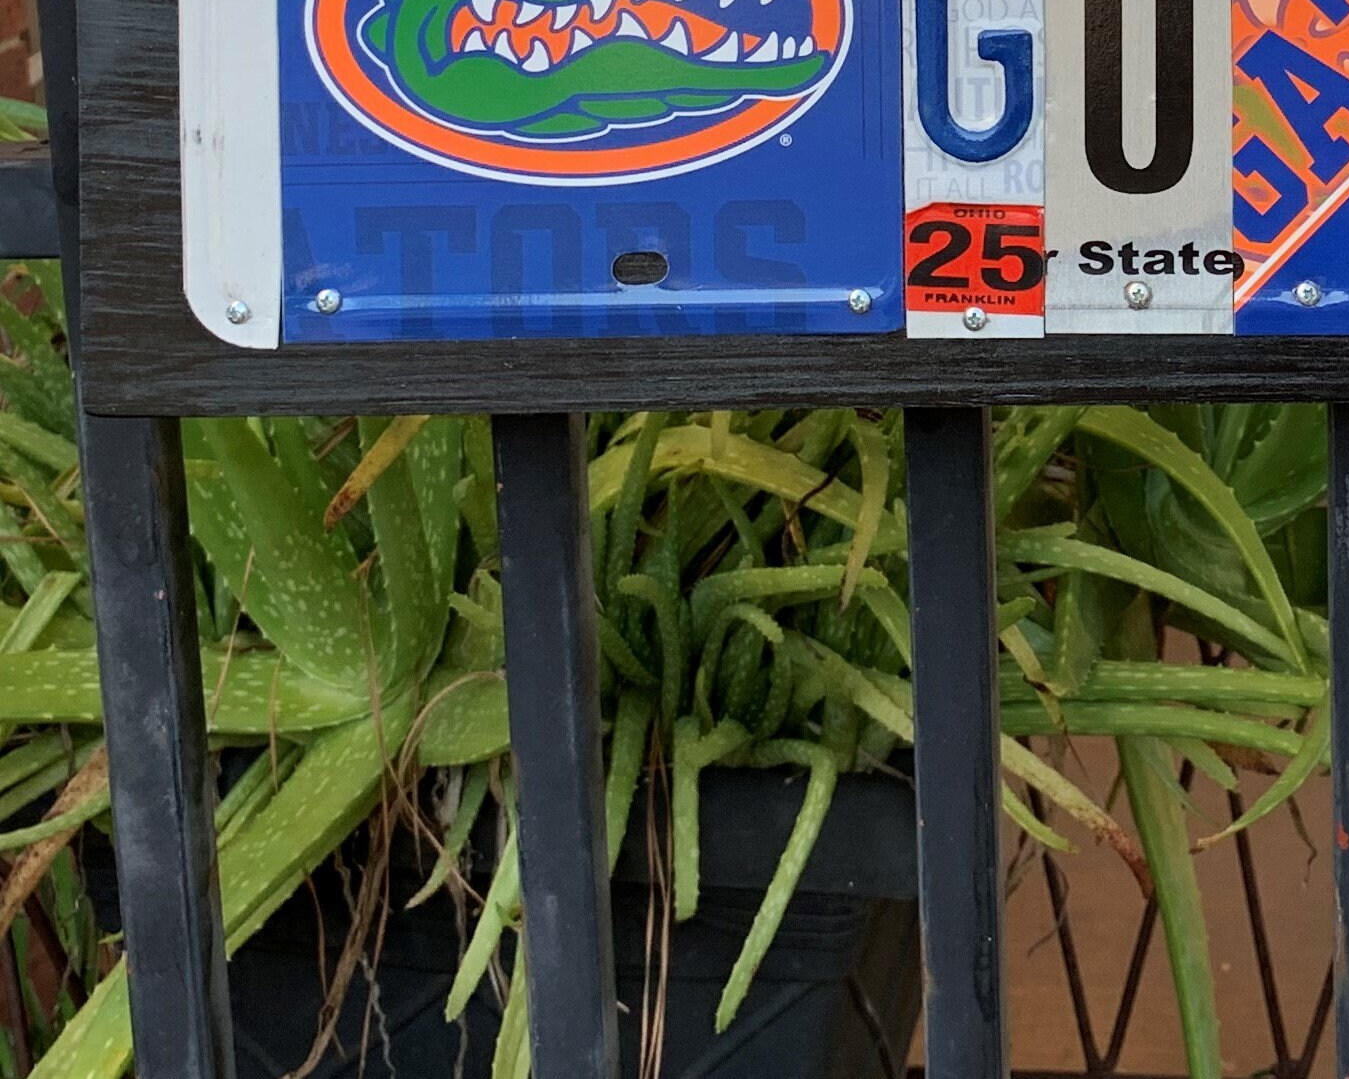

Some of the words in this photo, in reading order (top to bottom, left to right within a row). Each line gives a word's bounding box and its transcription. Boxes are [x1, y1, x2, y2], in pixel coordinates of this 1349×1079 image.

[953, 208, 1006, 220] OHIO
[907, 220, 1045, 292] 25
[1078, 240, 1236, 276] State
[924, 293, 1017, 306] FRANKLIN
